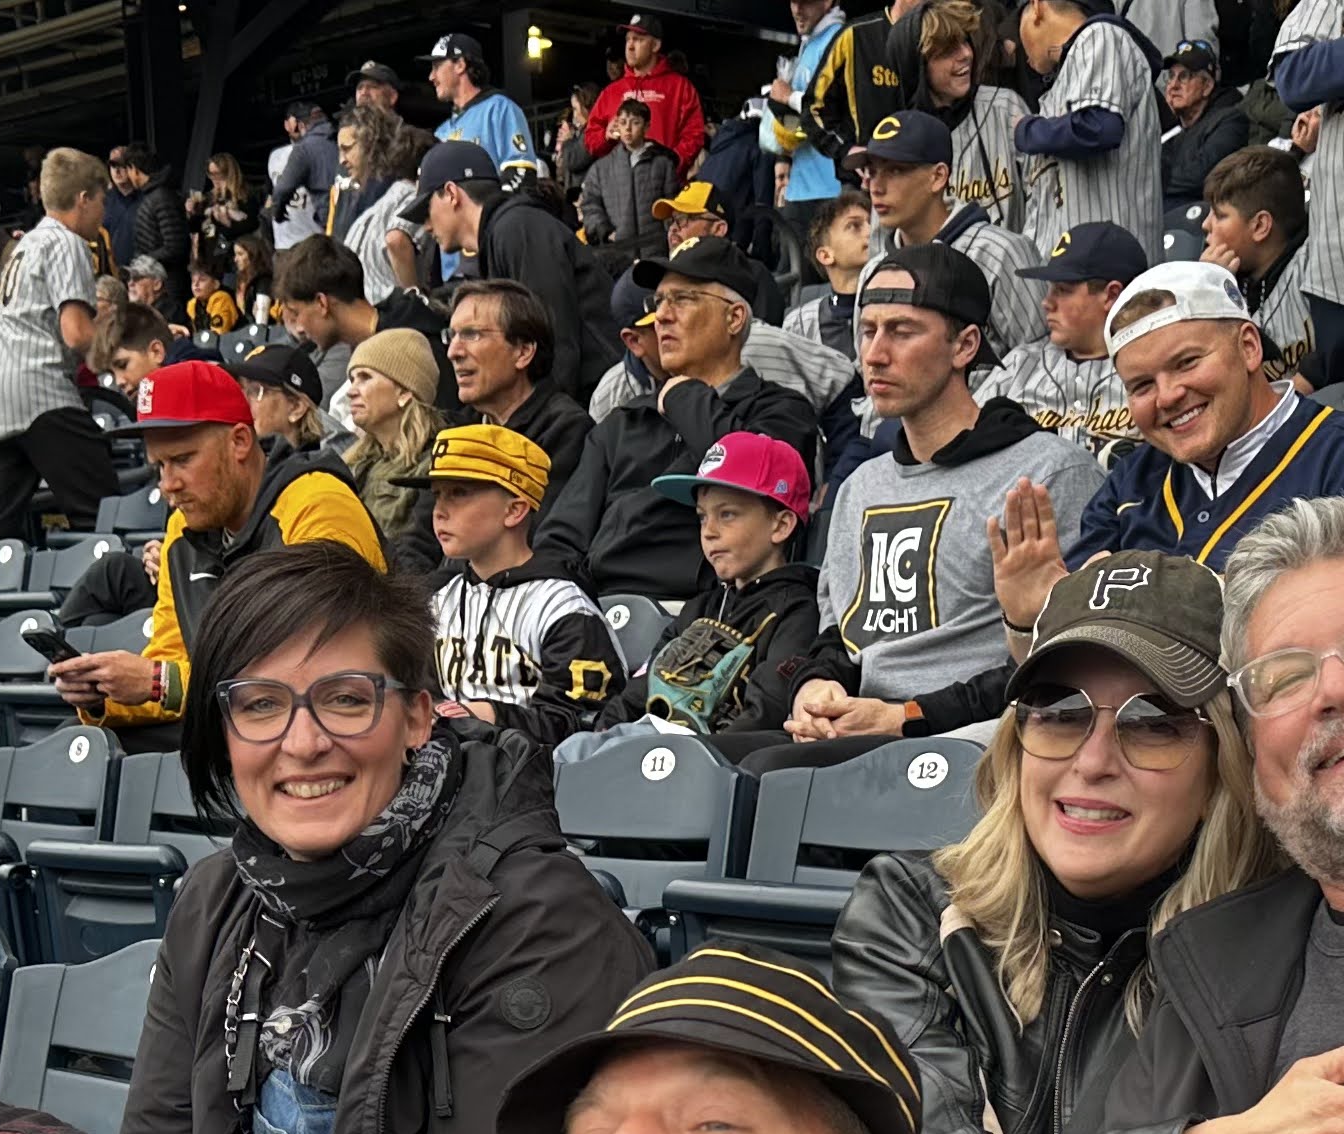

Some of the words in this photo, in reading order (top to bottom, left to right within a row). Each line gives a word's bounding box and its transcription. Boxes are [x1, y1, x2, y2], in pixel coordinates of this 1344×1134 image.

[872, 116, 901, 140] C
[1089, 563, 1153, 610] P
[613, 611, 622, 623] 9
[862, 606, 918, 633] LIGHT
[74, 743, 84, 756] 8
[651, 757, 665, 773] 11
[917, 762, 938, 779] 12
